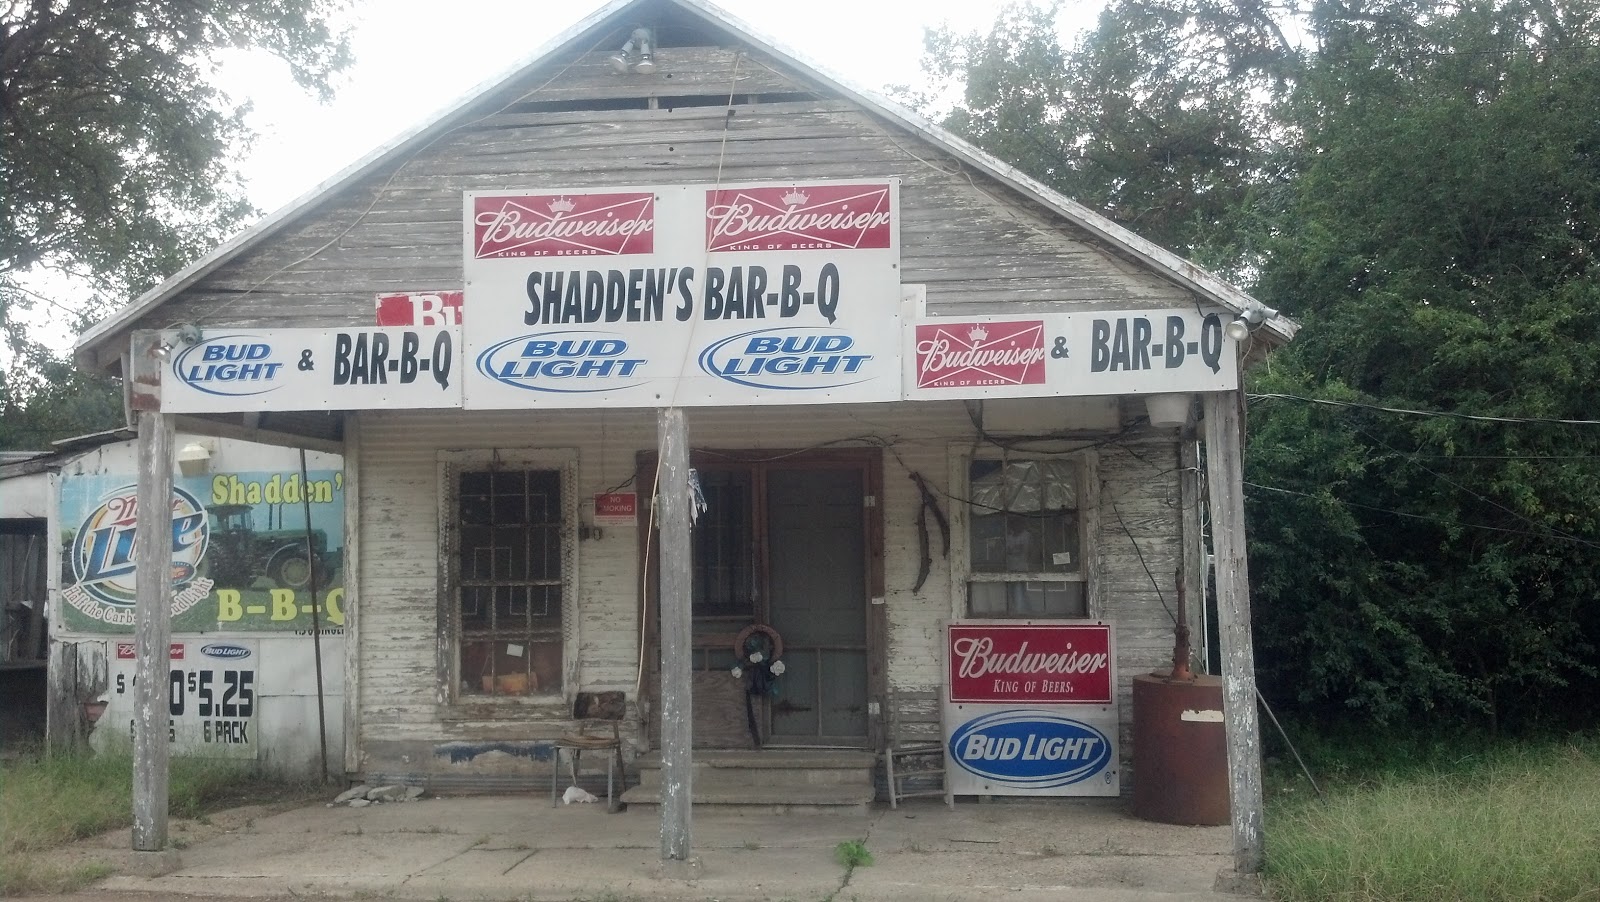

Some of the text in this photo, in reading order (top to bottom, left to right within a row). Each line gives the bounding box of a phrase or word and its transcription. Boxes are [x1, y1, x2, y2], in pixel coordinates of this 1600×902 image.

[475, 210, 654, 243] Budweiser
[706, 203, 889, 236] Budweiser
[524, 262, 840, 326] SHADDEN'S BAR-B-Q
[201, 343, 272, 362] BUD
[520, 339, 629, 359] BUD
[743, 335, 855, 356] BUD
[1050, 312, 1222, 375] & BAR-B-Q
[297, 330, 452, 391] & BAR-B-Q
[720, 355, 874, 376] LIGHT
[916, 340, 1045, 373] Budweiser
[187, 362, 284, 383] LIGHT
[498, 359, 648, 379] LIGHT
[223, 647, 247, 655] LIGHT
[954, 637, 1106, 678] Budweiser
[993, 679, 1019, 693] KING
[1024, 681, 1037, 693] OF
[204, 720, 248, 743] 6 PACK
[963, 734, 1098, 760] BUD LIGHT
